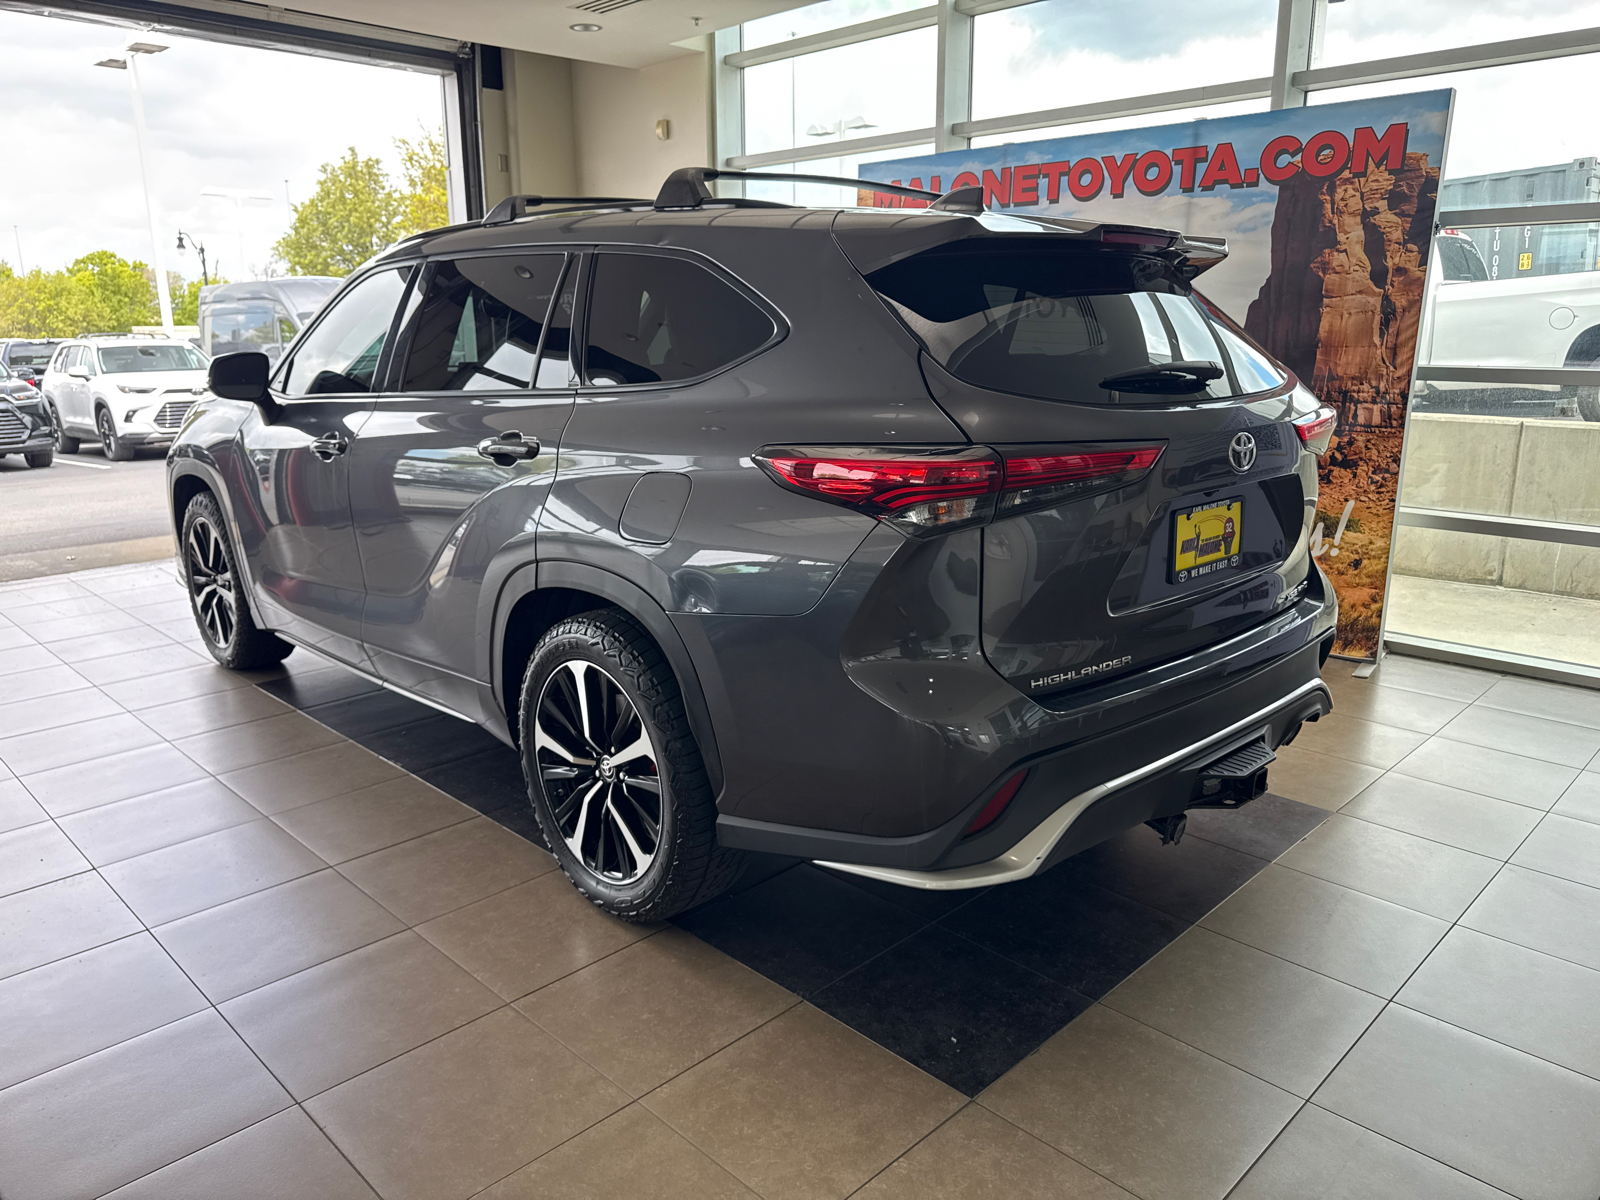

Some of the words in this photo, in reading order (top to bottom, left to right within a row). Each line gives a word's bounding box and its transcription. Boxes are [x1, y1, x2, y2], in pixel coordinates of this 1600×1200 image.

[1493, 227, 1501, 251] TU
[1203, 502, 1217, 511] MALONE
[1225, 522, 1233, 533] 32
[1191, 567, 1198, 578] WE
[1199, 564, 1211, 576] MAKE
[1211, 562, 1217, 572] IT
[1217, 559, 1228, 570] EASY
[1030, 655, 1132, 689] HIGHLANDER
